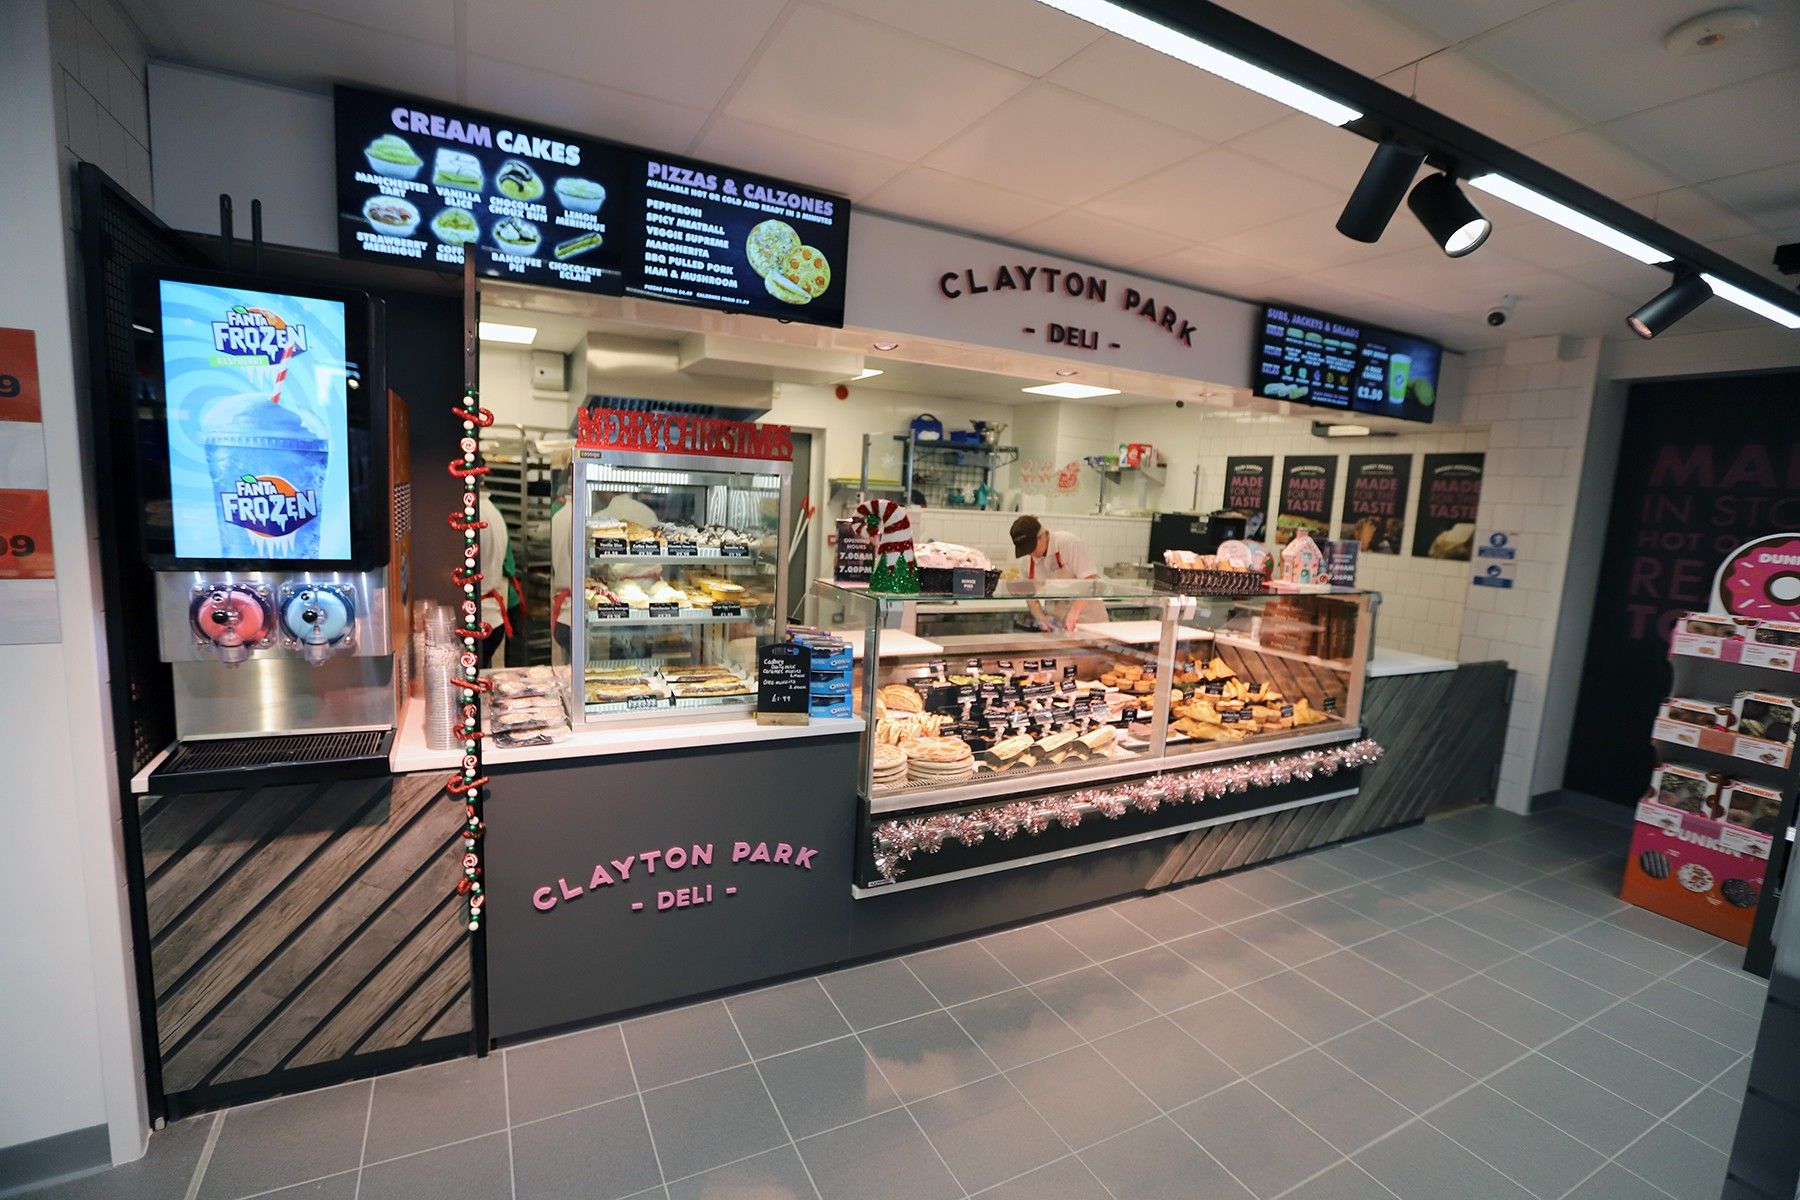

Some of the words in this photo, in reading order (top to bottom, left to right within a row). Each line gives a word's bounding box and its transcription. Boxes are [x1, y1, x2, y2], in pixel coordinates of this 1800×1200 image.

[390, 107, 492, 148] CREAM
[496, 130, 581, 166] CAKES
[355, 171, 429, 194] MANCHESTER
[648, 161, 718, 191] PIZZAS
[722, 178, 738, 196] &
[743, 183, 834, 216] CALZONES
[379, 185, 406, 198] TART
[435, 186, 482, 203] VANILLA
[646, 179, 690, 195] AVAILABLE
[690, 188, 708, 198] HOT
[722, 196, 742, 206] COLD
[743, 200, 760, 210] AND
[444, 196, 473, 210] SLICE
[489, 196, 547, 214] CHOCOLATE
[646, 198, 702, 218] PEPPERONI
[488, 204, 524, 218] CHOUX
[526, 210, 548, 222] BUN
[564, 210, 598, 223] LEMON
[556, 216, 606, 232] MERINGUE
[646, 212, 674, 226] SPICY
[676, 218, 725, 236] MEATBALL
[356, 231, 428, 250] STRAWBERRY
[646, 226, 683, 240] VEGGIE
[684, 233, 729, 249] SUPREME
[363, 241, 422, 258] MERINGUE
[437, 244, 464, 257] COFF
[646, 239, 710, 258] MARGHERITA
[491, 252, 542, 268] BANOFFEE
[508, 262, 525, 273] PIE
[645, 252, 666, 264] BBQ
[668, 256, 705, 270] PULLED
[706, 262, 734, 275] PORK
[548, 261, 602, 277] CHOCOLATE
[644, 265, 668, 277] HAM
[670, 270, 678, 279] &
[680, 271, 738, 288] MUSHROOM
[938, 264, 1107, 302] CLAYTON
[1122, 288, 1198, 348] PARK
[226, 311, 269, 327] FANTA
[211, 320, 307, 360] FROZEN
[1048, 322, 1099, 350] DELI
[235, 480, 278, 496] FANTA
[1231, 476, 1264, 487] MADE
[1289, 478, 1326, 490] MADE
[1355, 478, 1399, 490] MADE
[220, 489, 317, 531] FROZEN
[1230, 496, 1261, 508] TASTE
[1288, 500, 1324, 512] TASTE
[1353, 501, 1394, 514] TASTE
[840, 552, 873, 560] 7.00AM
[839, 566, 872, 574] 7.00PM
[772, 694, 791, 702] £1.99
[532, 844, 714, 911] CLAYTON
[732, 841, 818, 870] PARK
[657, 884, 712, 911] DELI
